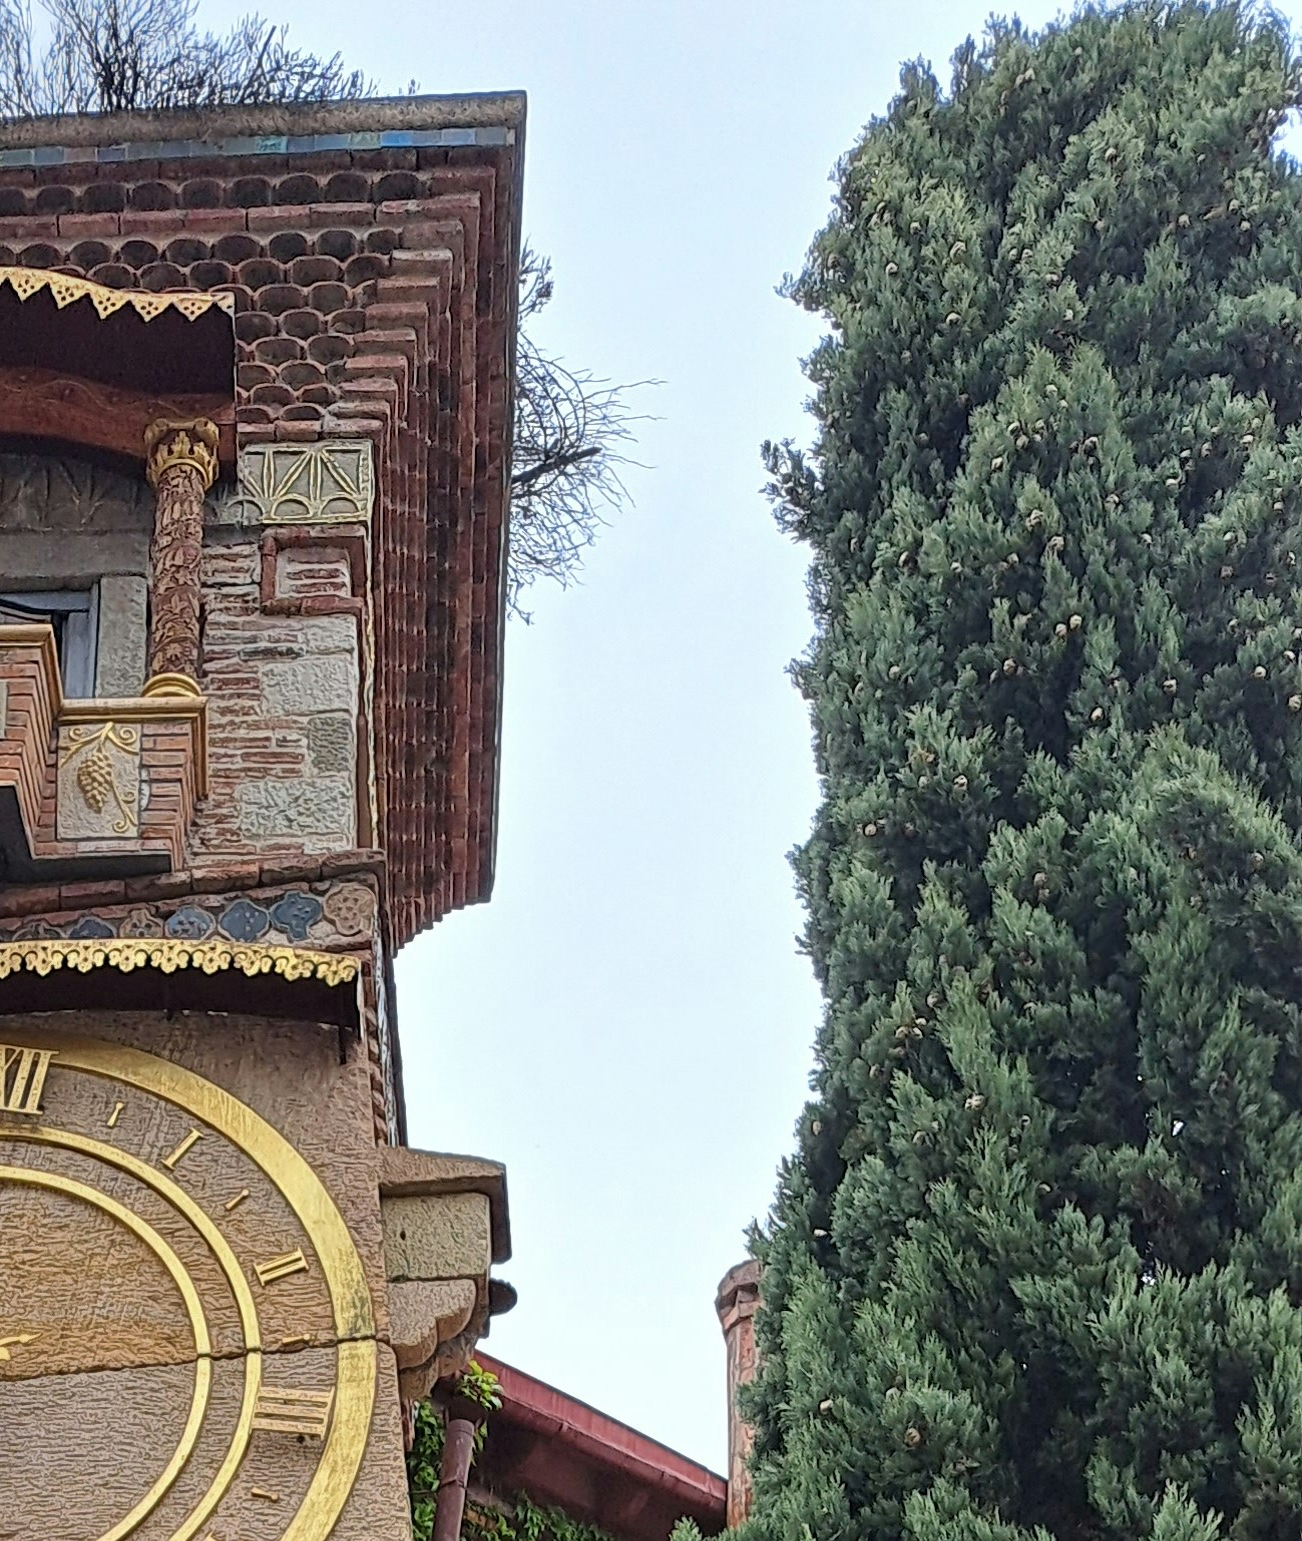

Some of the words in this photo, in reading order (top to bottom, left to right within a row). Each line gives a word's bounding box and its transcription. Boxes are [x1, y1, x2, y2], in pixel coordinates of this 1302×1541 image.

[161, 1128, 204, 1170] I
[253, 1249, 309, 1287] II
[249, 1381, 335, 1440] III
